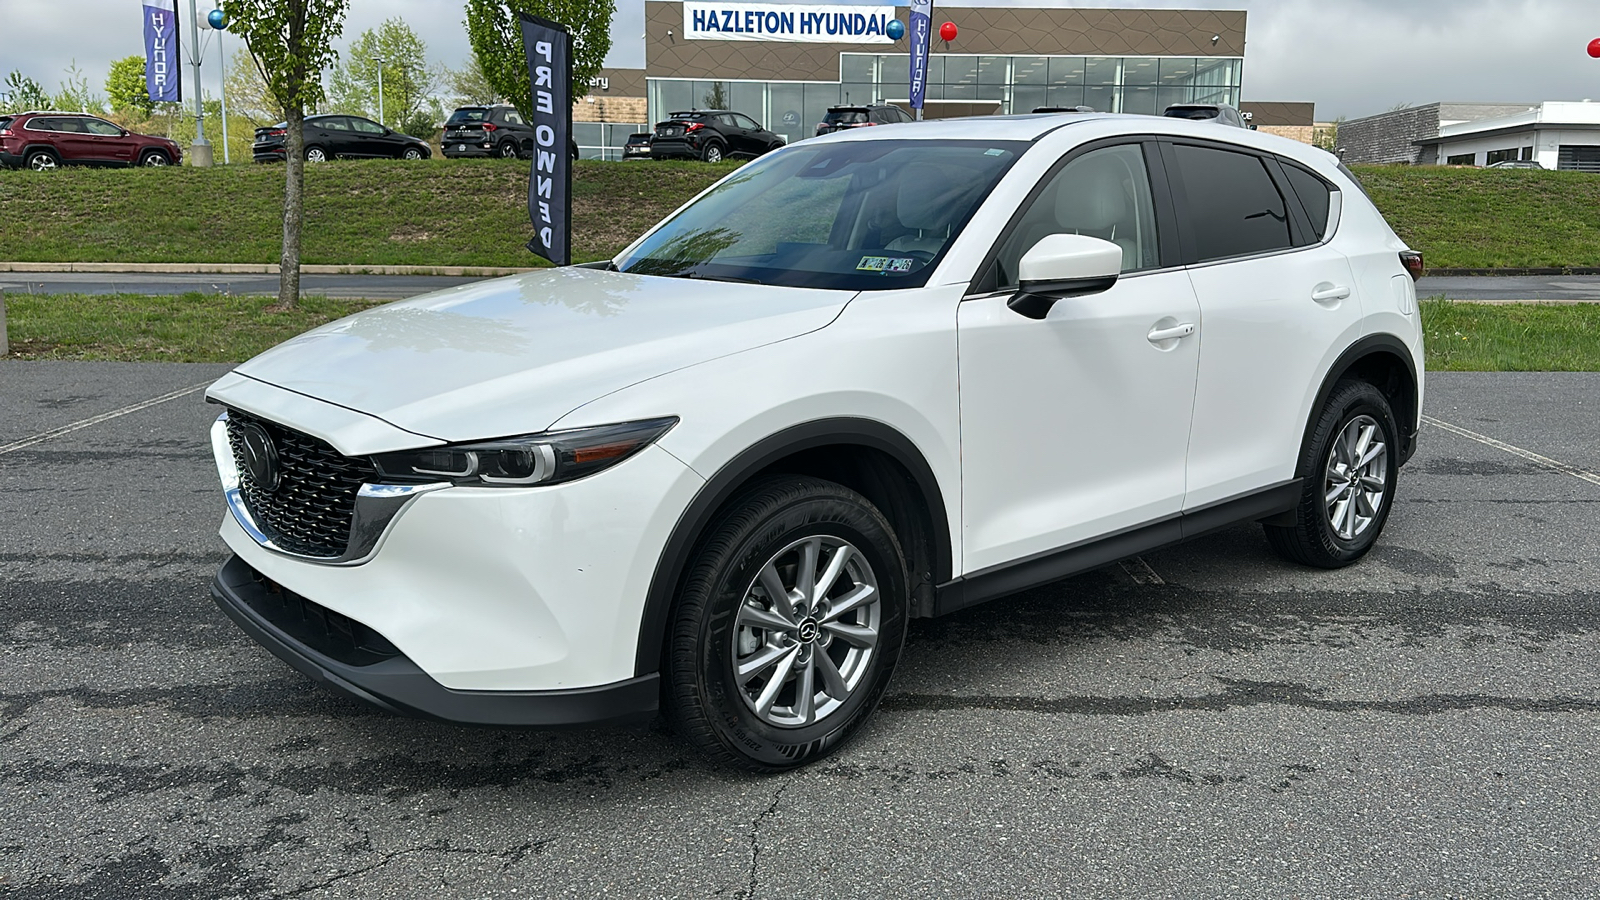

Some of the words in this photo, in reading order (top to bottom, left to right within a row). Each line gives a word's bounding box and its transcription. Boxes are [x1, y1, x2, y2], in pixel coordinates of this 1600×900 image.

[151, 12, 166, 98] HYUNDAI
[693, 10, 794, 34] HAZLETON
[800, 12, 885, 36] HYUNDAI
[912, 19, 926, 98] HYUNDAI
